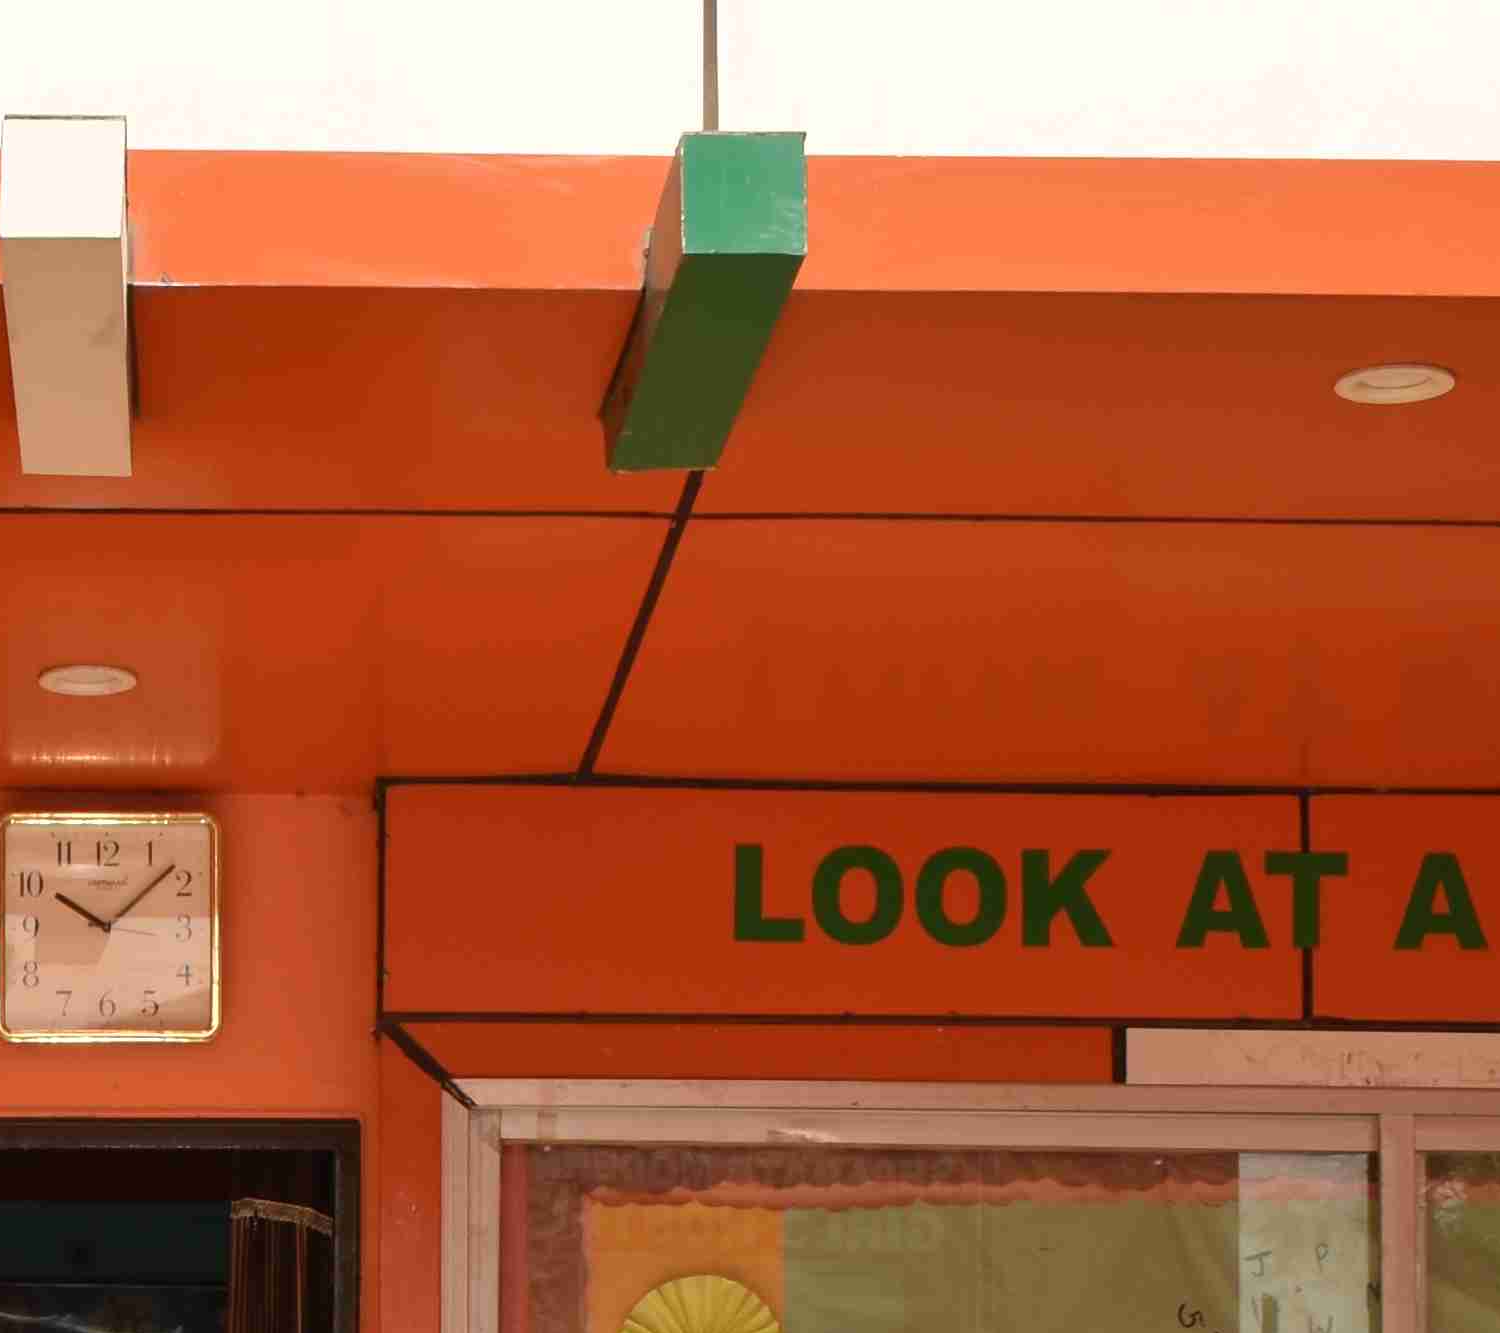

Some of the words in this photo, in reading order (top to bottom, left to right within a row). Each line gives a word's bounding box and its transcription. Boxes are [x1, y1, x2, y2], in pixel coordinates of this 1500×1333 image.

[56, 840, 72, 866] 11
[96, 840, 120, 867] 12
[18, 871, 44, 897] 10
[175, 871, 193, 897] 2
[732, 843, 1114, 948] LOOK
[1176, 850, 1348, 949] AT
[1393, 851, 1489, 952] A
[22, 914, 40, 938] 9
[175, 914, 192, 942] 3
[22, 960, 39, 988] 8
[176, 963, 193, 987] 4
[55, 991, 72, 1017] 7
[99, 990, 116, 1017] 6
[141, 990, 160, 1017] 5
